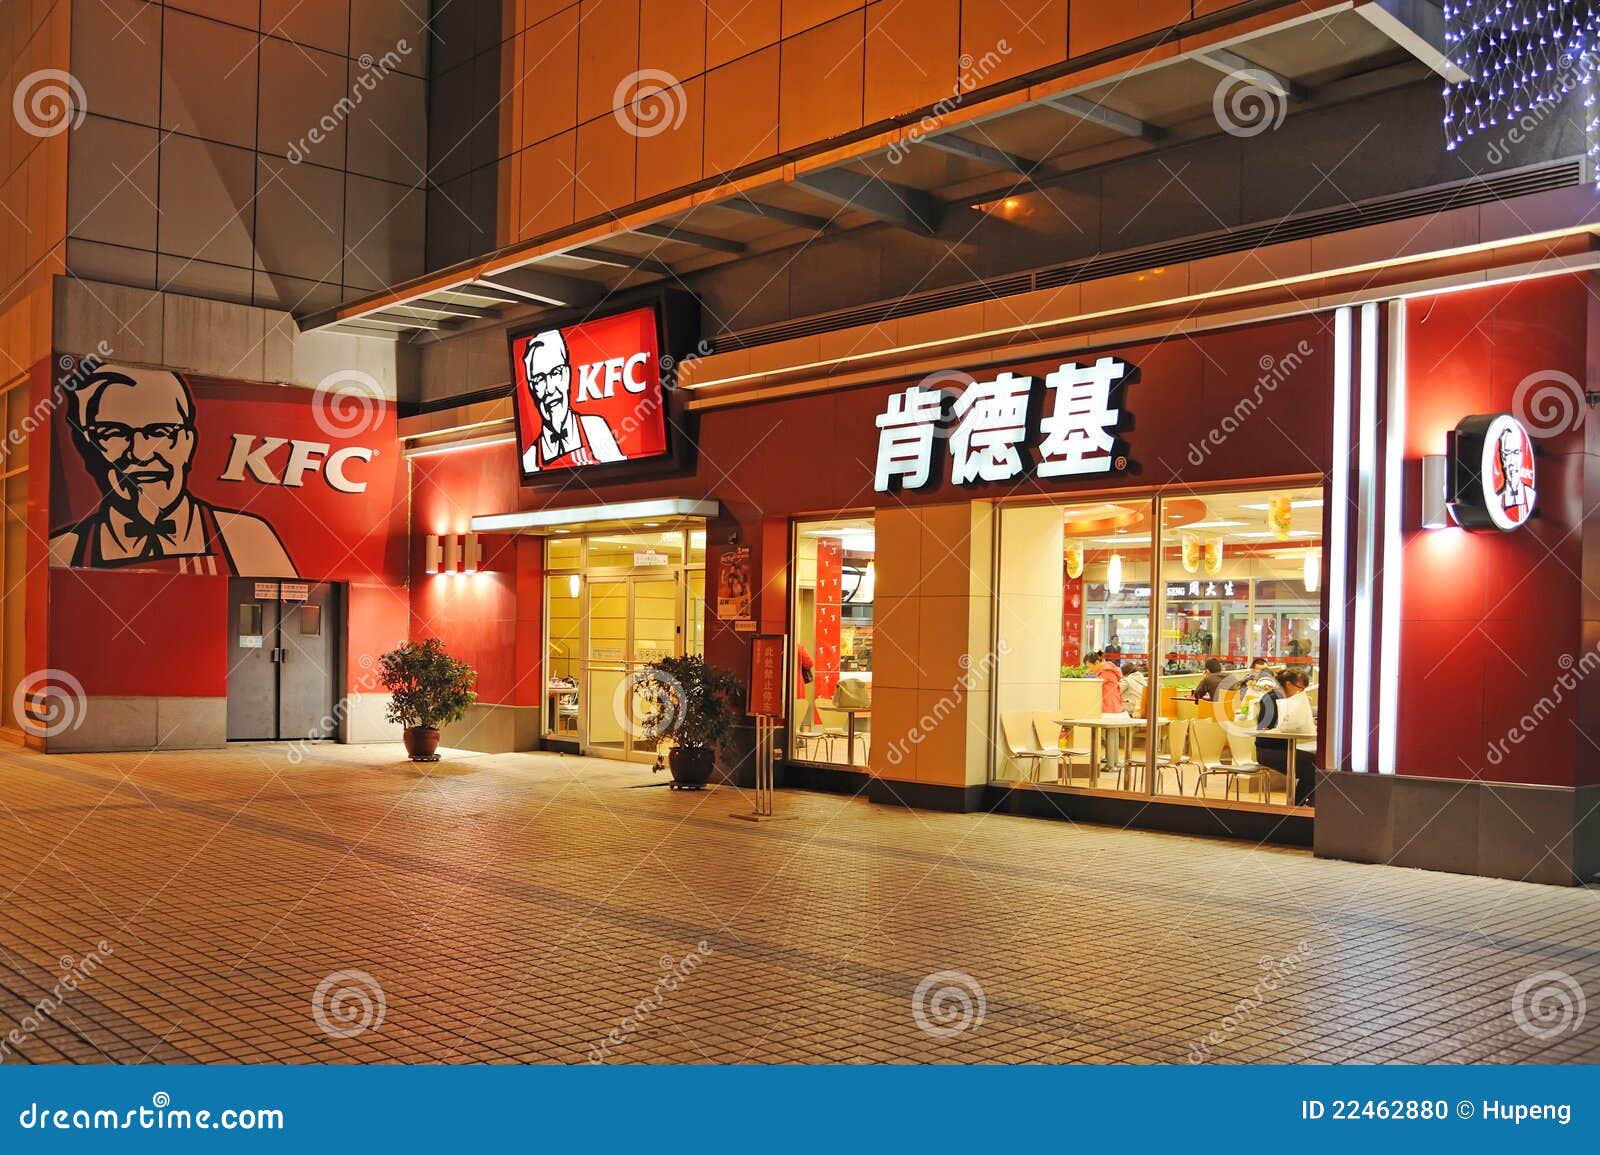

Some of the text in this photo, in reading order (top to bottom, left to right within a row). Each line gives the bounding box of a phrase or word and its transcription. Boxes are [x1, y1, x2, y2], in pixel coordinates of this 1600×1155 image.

[576, 352, 647, 402] KFC
[874, 356, 1125, 491] 肯德基
[219, 433, 373, 493] KFC
